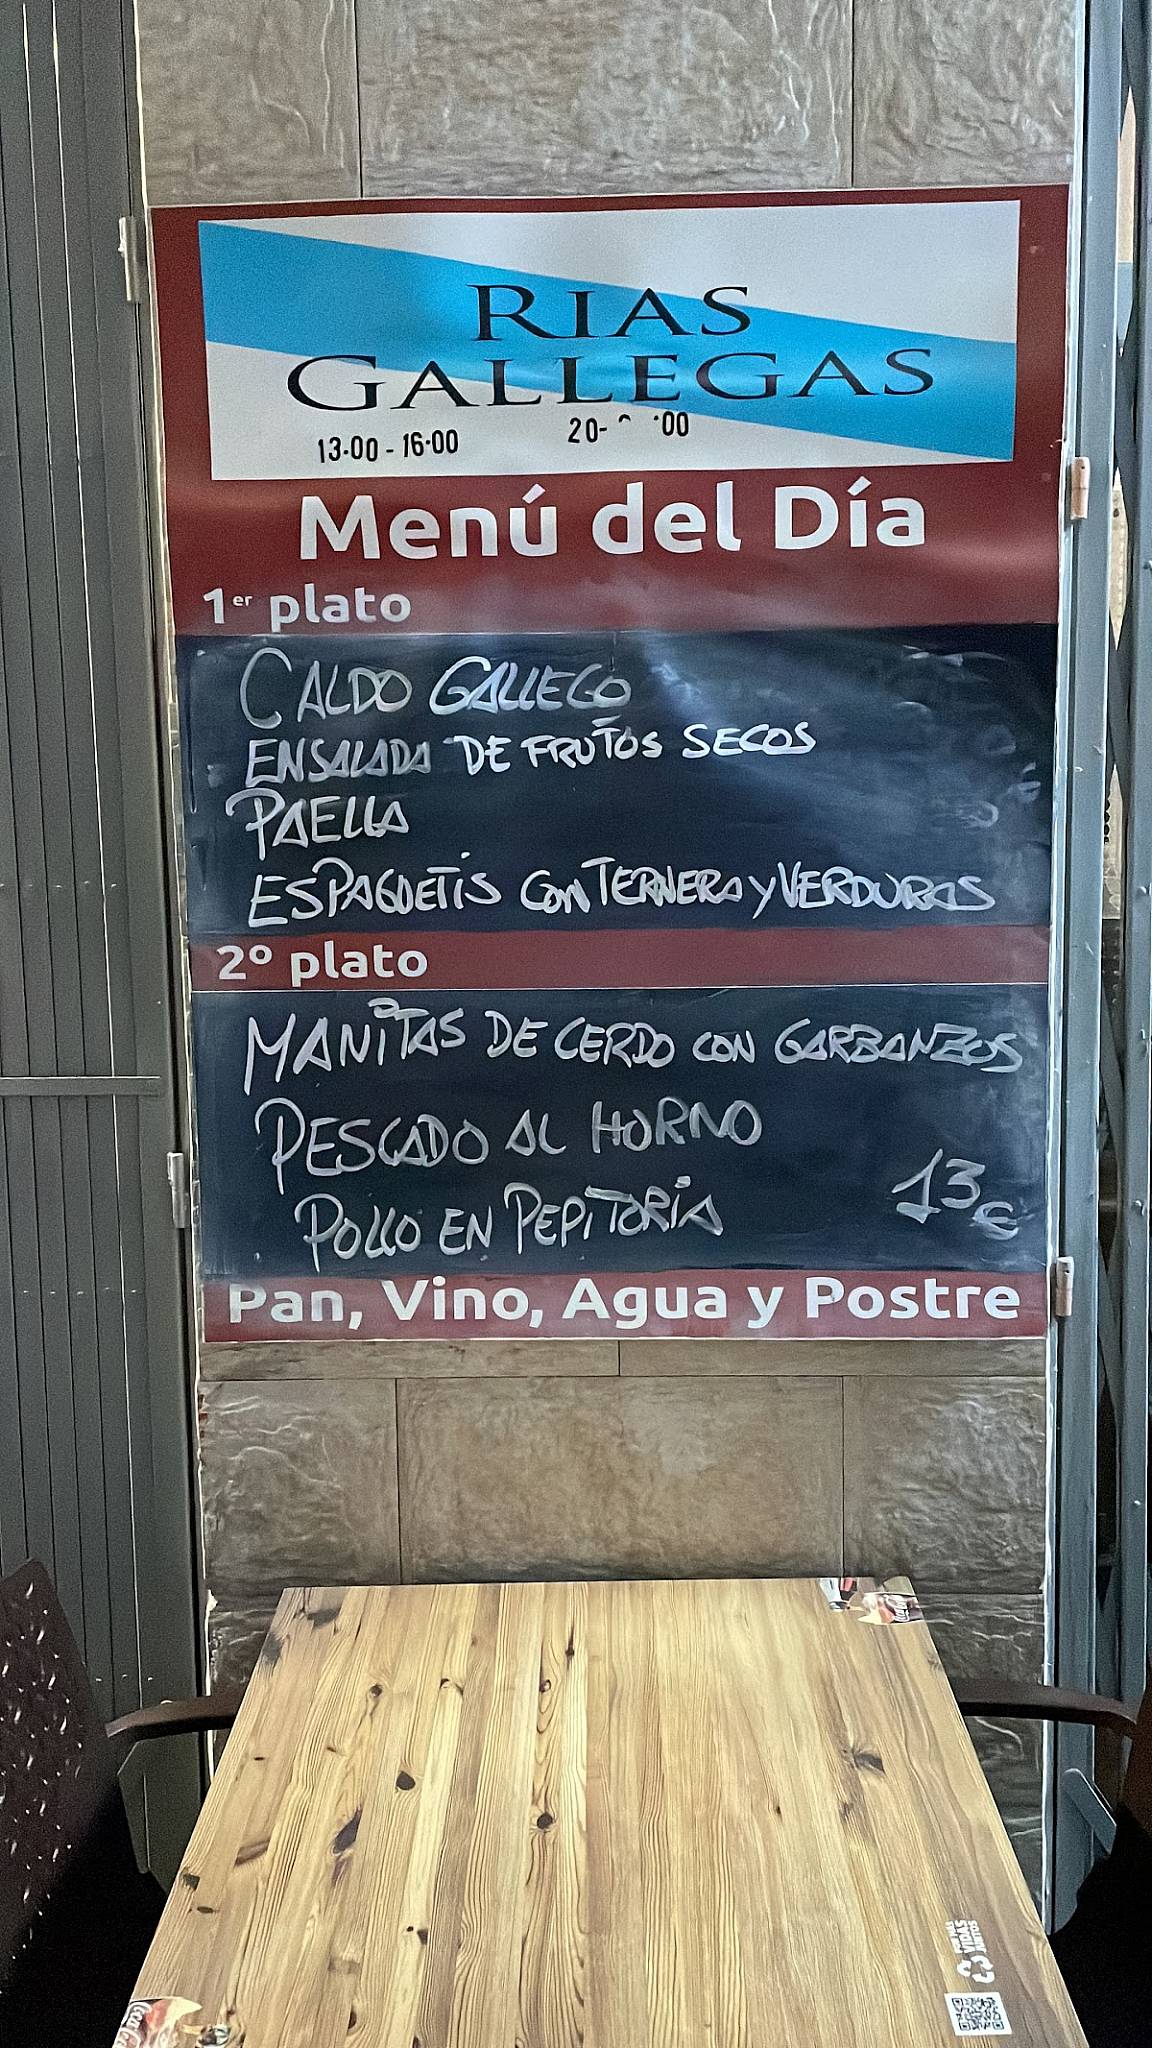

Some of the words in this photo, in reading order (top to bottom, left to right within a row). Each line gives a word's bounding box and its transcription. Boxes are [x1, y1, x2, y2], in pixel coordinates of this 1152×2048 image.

[466, 284, 750, 342] RIAS
[287, 348, 935, 412] GALLEGAS
[299, 483, 558, 562] Menú
[592, 480, 742, 556] del
[774, 475, 926, 552] Día
[270, 583, 412, 633] plato
[240, 647, 412, 729] CALDO
[429, 655, 631, 717] GALLEGO
[245, 738, 431, 787] ENSALADA
[444, 734, 512, 775] DE
[520, 715, 663, 768] FRUTOS
[682, 721, 816, 758] SECOS
[225, 787, 409, 861] PAELLA
[581, 857, 743, 907] TERNERA
[777, 861, 995, 911] VERDURAS
[291, 940, 428, 987] plato
[243, 997, 466, 1095] MANITAS
[484, 1009, 548, 1058] DE
[554, 1016, 675, 1068] CERDO
[692, 1029, 755, 1063] CON
[775, 1018, 1022, 1073] GARBANZOS
[254, 1097, 489, 1195] PESCADO
[505, 1110, 567, 1156] AL
[591, 1097, 763, 1153] HORNO
[294, 1193, 421, 1272] POLLO
[439, 1206, 493, 1256] EN
[504, 1176, 723, 1254] PEPITORIA
[228, 1284, 363, 1331] Pan,
[381, 1276, 543, 1328] Vino,
[562, 1278, 727, 1329] Agua
[747, 1286, 784, 1329] y
[805, 1276, 1021, 1320] Postre
